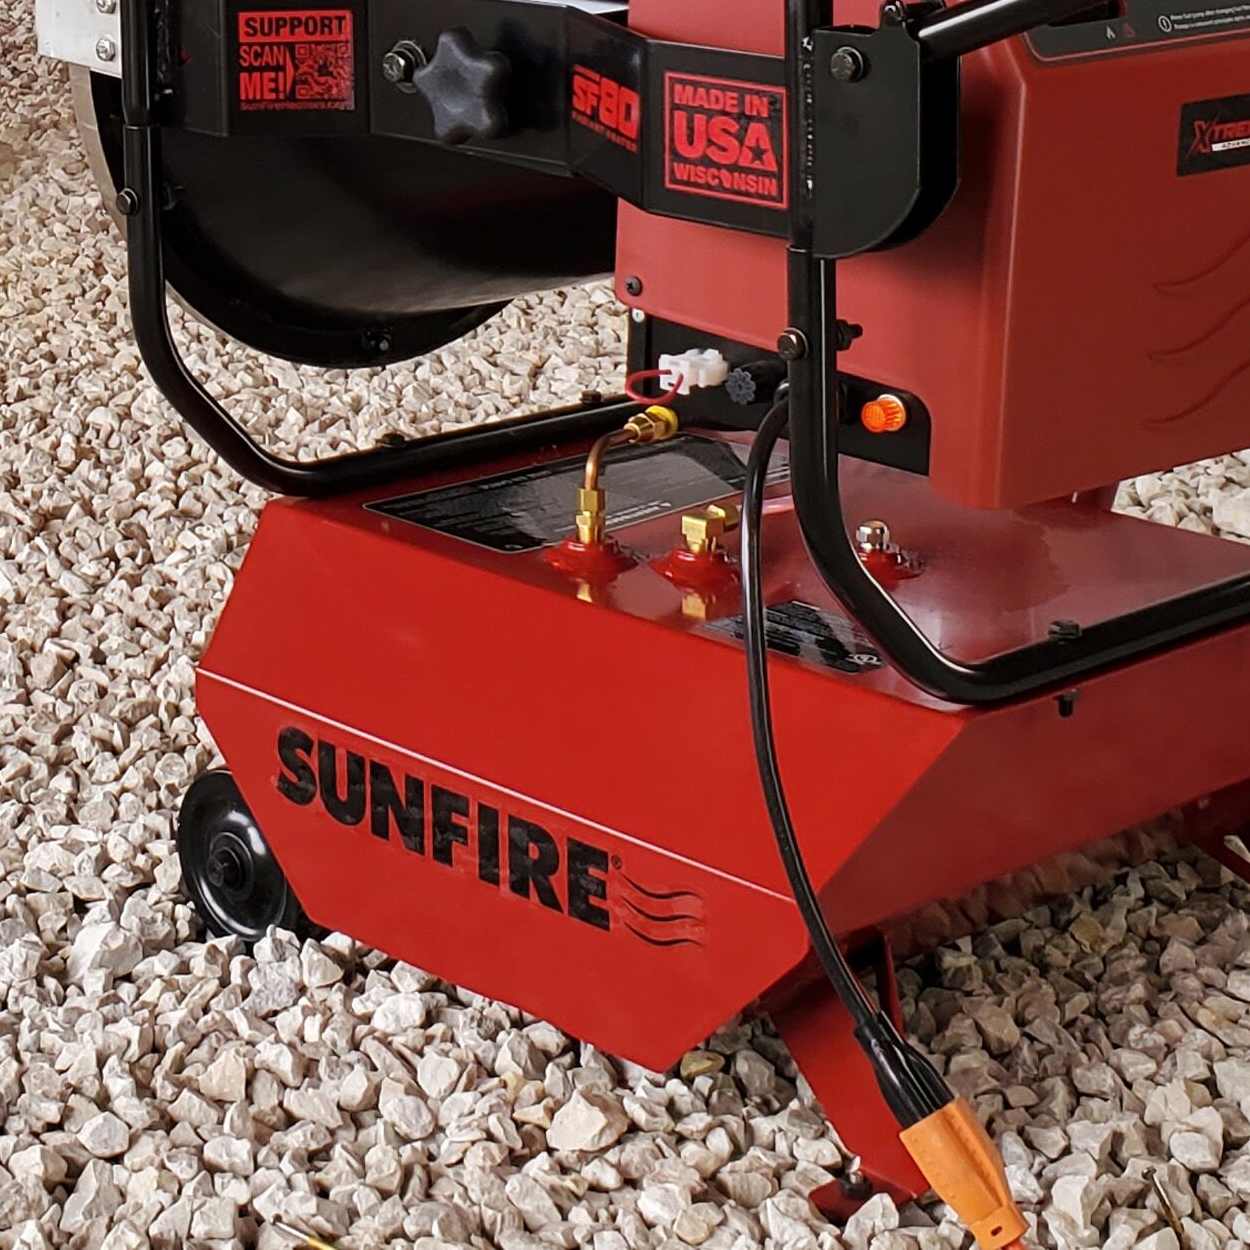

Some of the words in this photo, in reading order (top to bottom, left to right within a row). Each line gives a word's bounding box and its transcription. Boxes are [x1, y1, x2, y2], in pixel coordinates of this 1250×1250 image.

[244, 16, 346, 37] SUPPORT
[239, 45, 284, 67] SCAN
[239, 72, 285, 100] ME!
[673, 83, 739, 113] MADE
[744, 94, 769, 118] IN
[673, 110, 778, 171] USA
